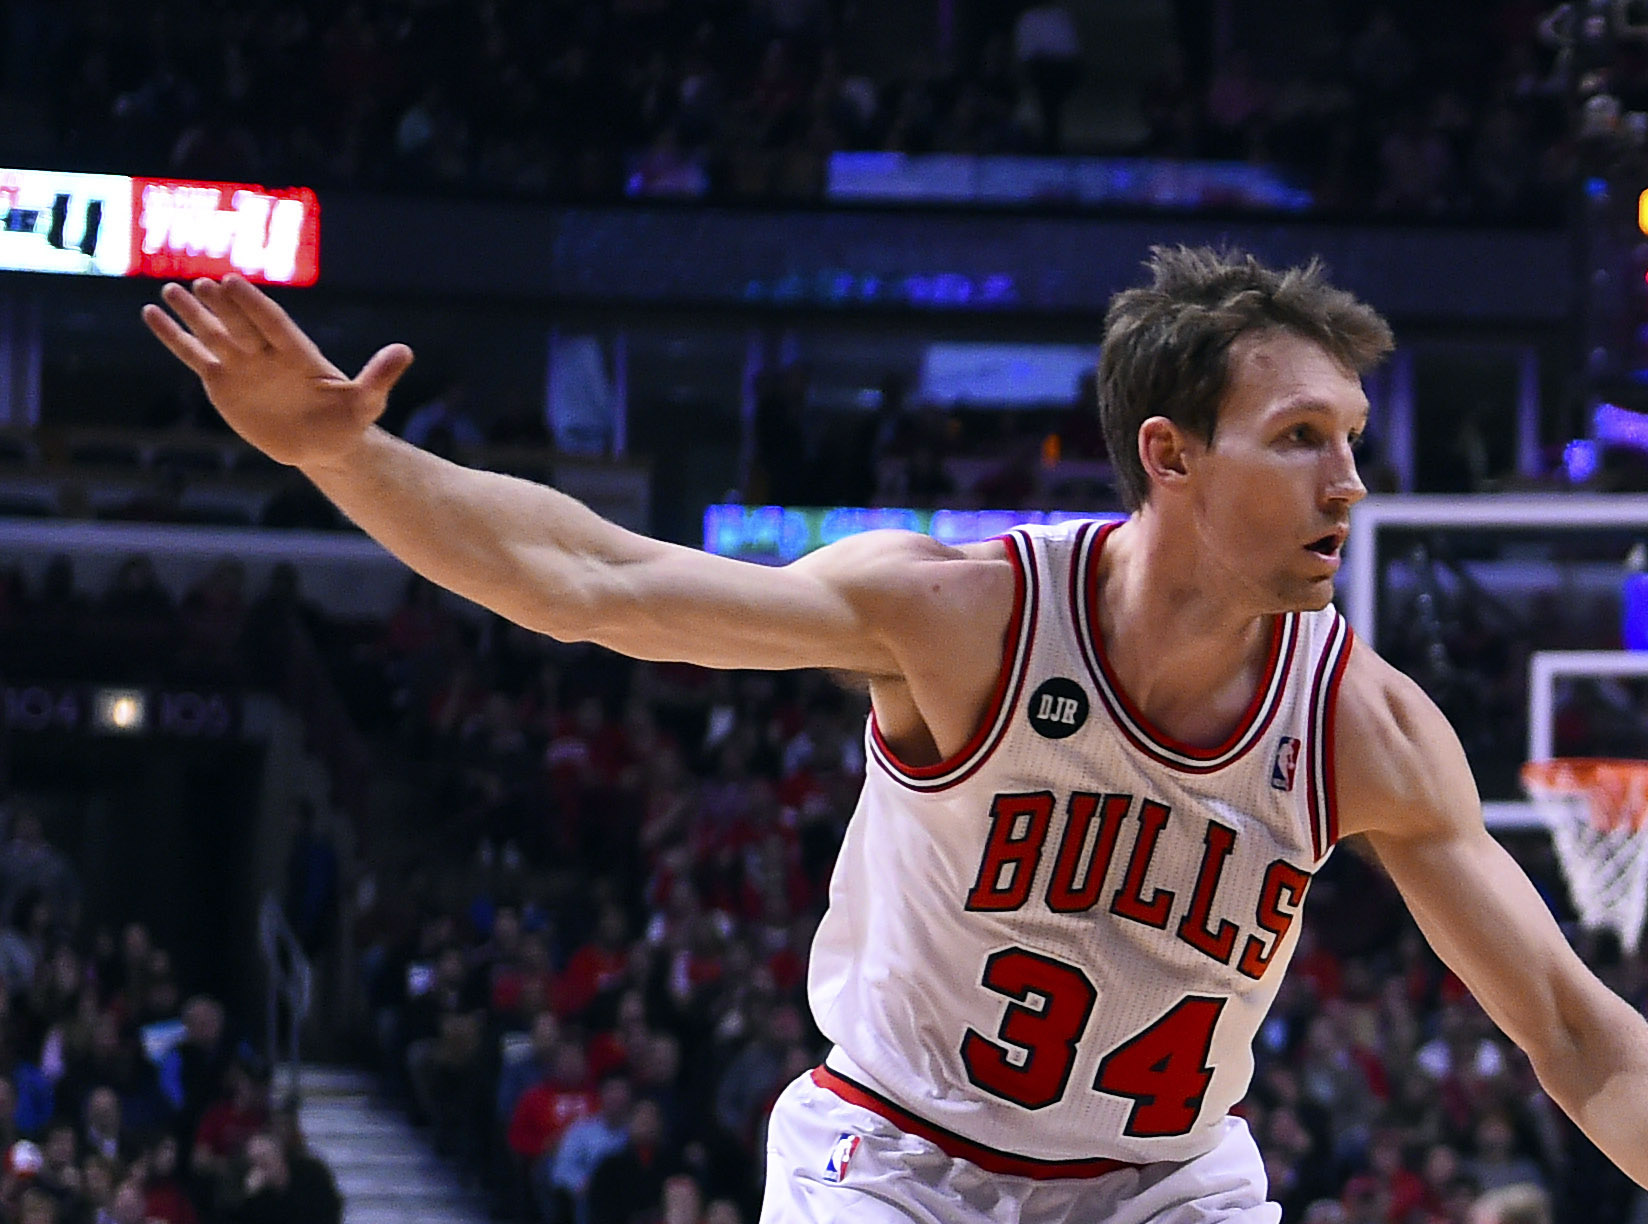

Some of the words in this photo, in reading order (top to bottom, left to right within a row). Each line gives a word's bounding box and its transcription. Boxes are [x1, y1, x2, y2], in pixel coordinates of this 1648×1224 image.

[1036, 693, 1079, 725] DJR
[964, 789, 1312, 981] BULLS
[959, 945, 1228, 1138] 34
